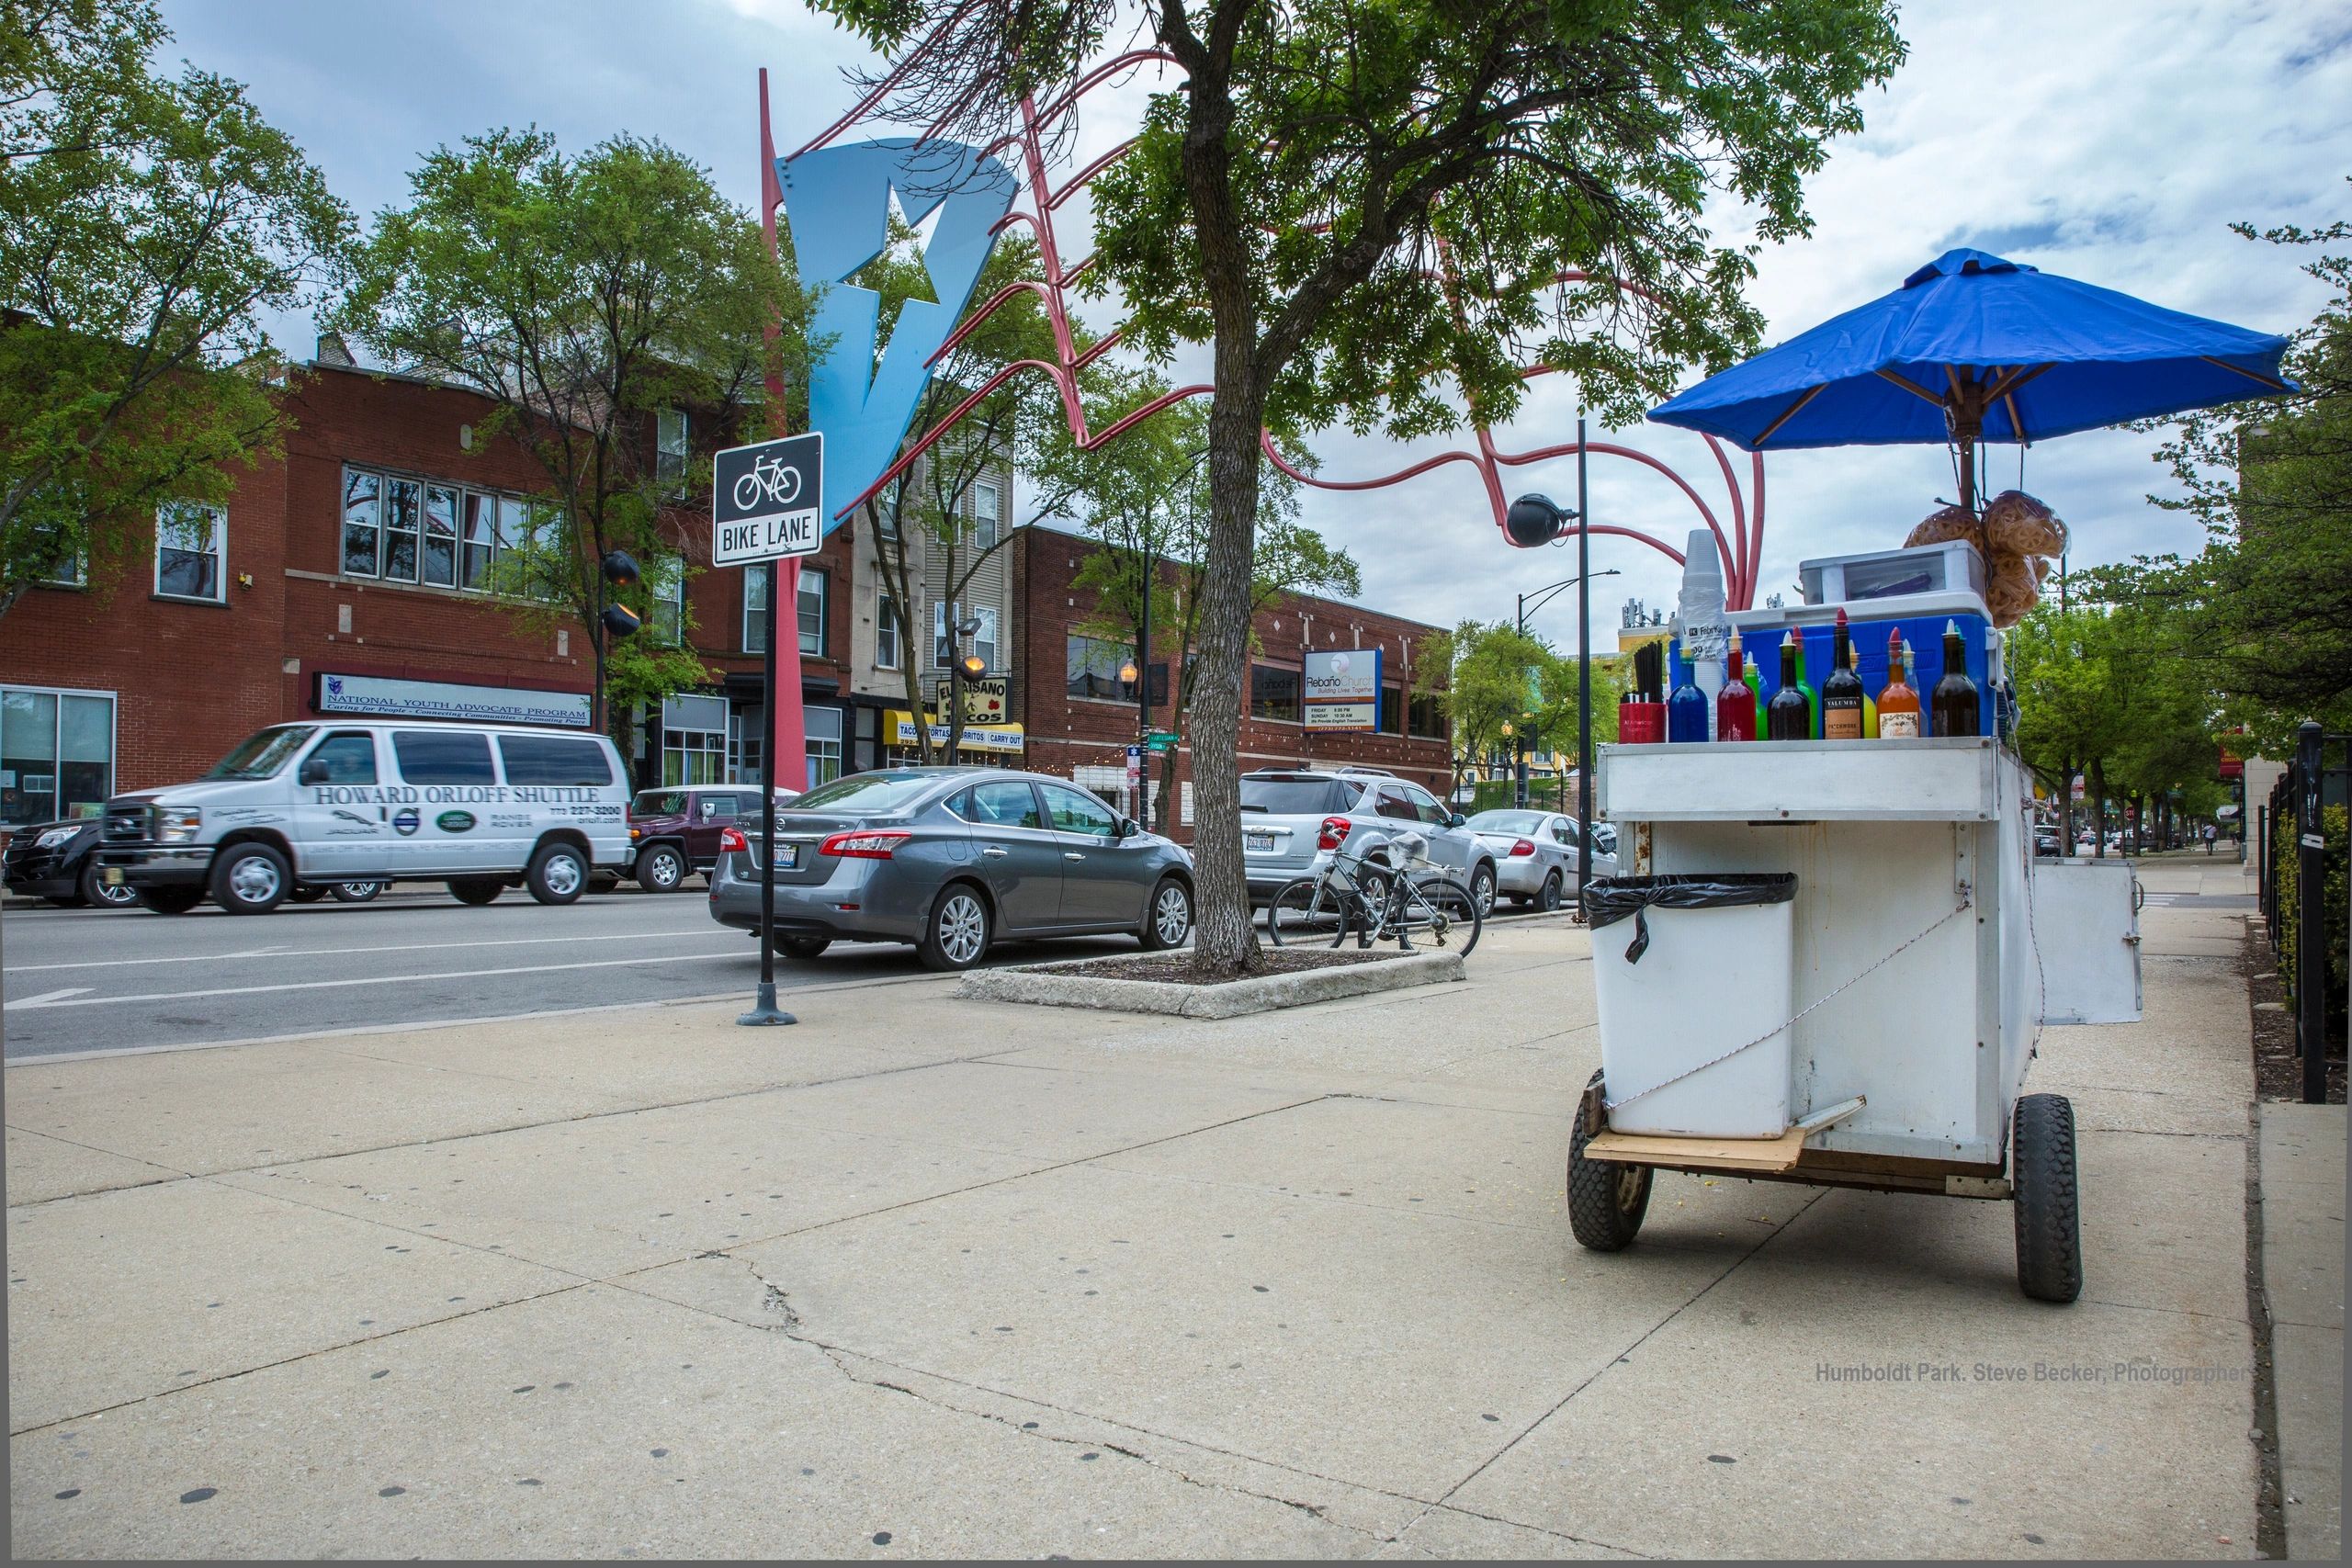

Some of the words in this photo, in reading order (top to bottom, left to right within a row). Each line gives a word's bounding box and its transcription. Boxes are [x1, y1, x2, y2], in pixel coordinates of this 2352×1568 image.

[722, 525, 759, 552] BIKE
[767, 515, 811, 546] LANE
[963, 681, 1005, 696] AISANO
[1306, 675, 1341, 687] Rebaño
[1341, 675, 1374, 687] Church
[327, 694, 398, 705] NATIONAL
[403, 699, 450, 709] YOUTH
[454, 703, 523, 714] ADVOCATE
[527, 707, 585, 717] PROGRAM
[327, 704, 359, 712] Caring
[359, 705, 375, 713] for
[415, 708, 461, 718] Connecting
[465, 712, 516, 720] Communities
[524, 716, 562, 724] Promoting
[943, 713, 1001, 723] TCOS
[899, 726, 917, 736] TACO
[989, 734, 1009, 743] CARRY
[1010, 736, 1021, 745] OUT
[314, 786, 419, 805] HOWARD
[425, 786, 507, 804] ORLOFF
[514, 786, 600, 803] SHUTTLE
